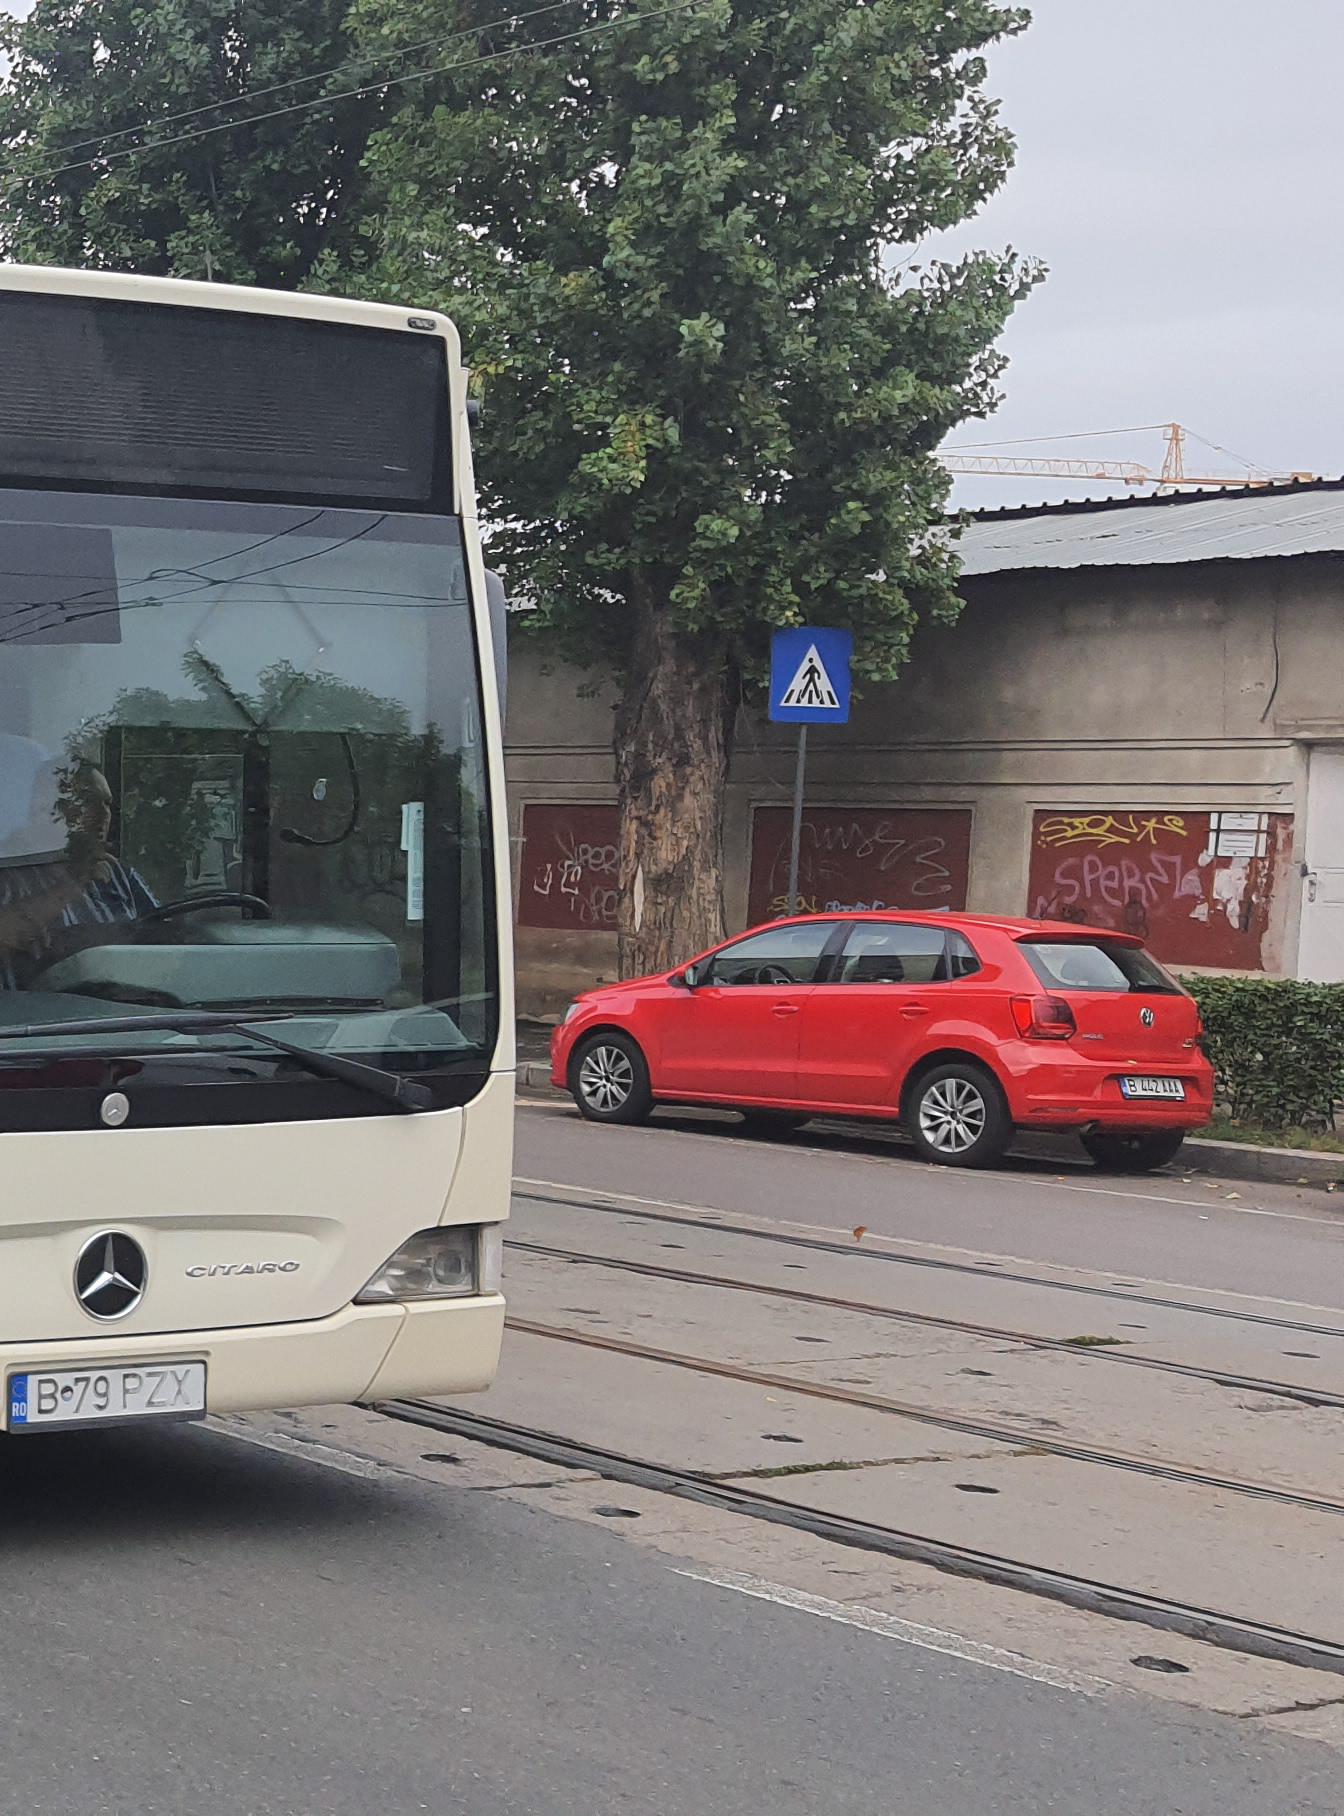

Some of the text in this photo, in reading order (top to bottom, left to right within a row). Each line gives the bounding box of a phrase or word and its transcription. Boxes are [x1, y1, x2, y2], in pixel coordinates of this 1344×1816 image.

[1128, 1079, 1138, 1093] B
[185, 1260, 300, 1279] CITARO
[12, 1369, 191, 1417] RO B 79 PZX
